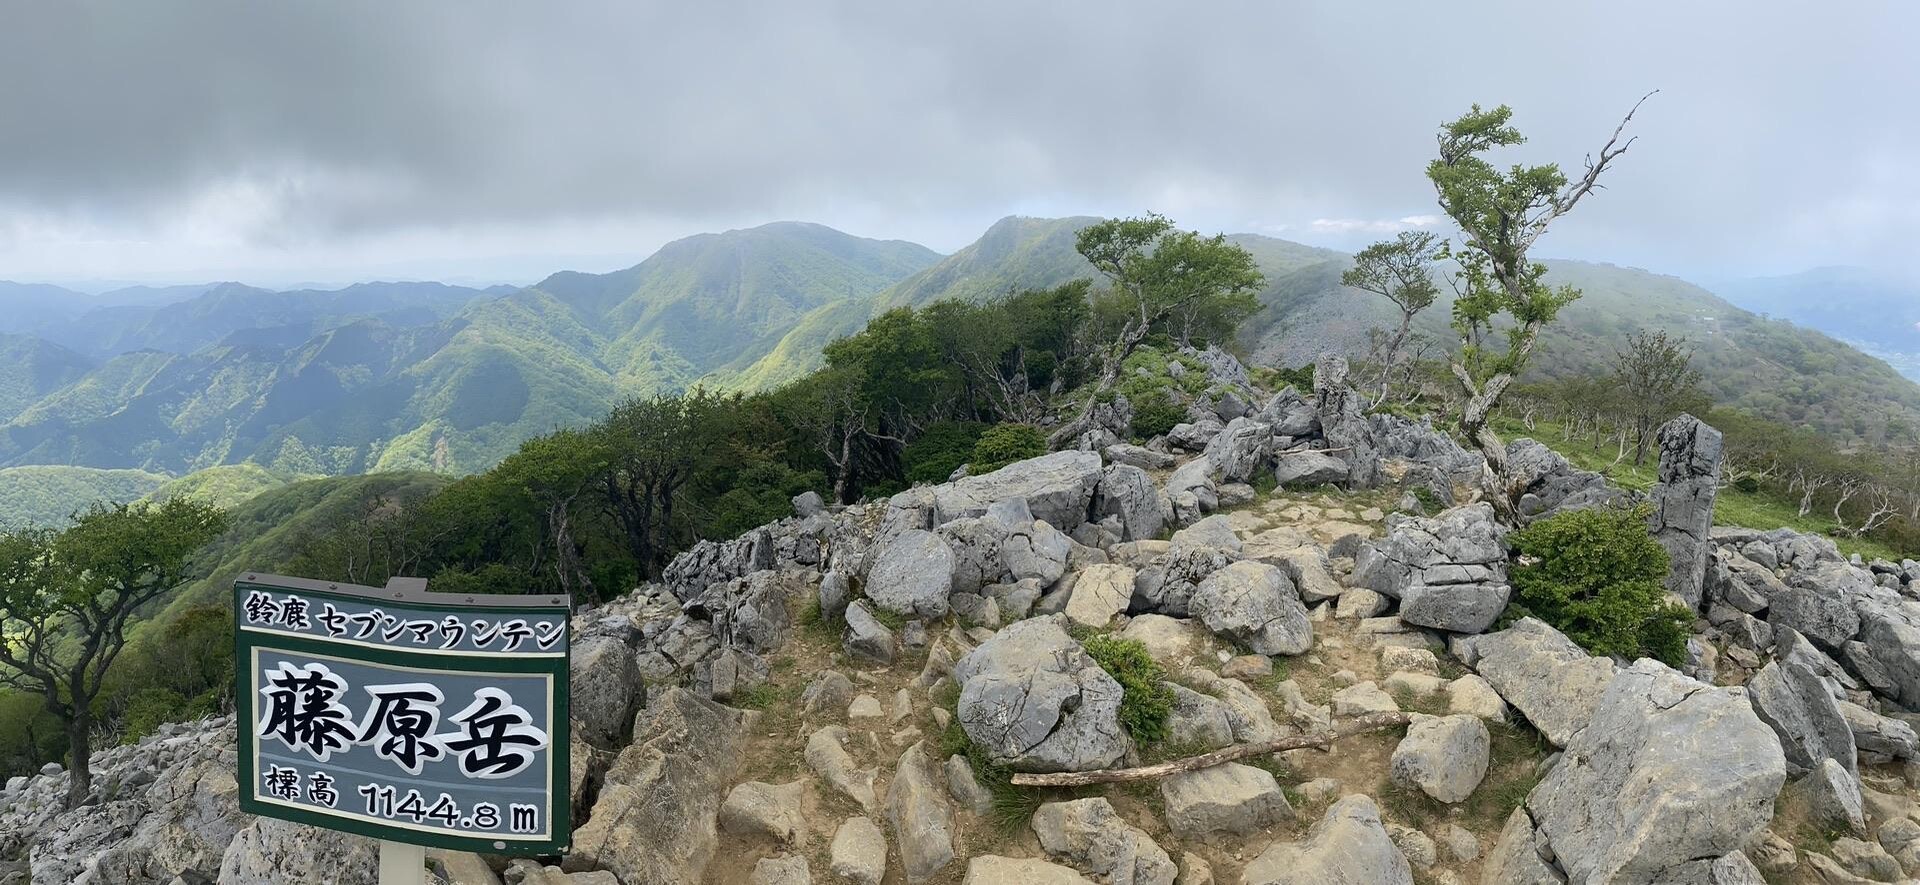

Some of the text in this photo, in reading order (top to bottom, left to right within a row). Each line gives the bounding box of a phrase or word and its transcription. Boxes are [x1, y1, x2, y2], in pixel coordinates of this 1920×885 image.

[246, 592, 565, 650] 鈴鹿 セブンマウンテン
[260, 665, 544, 776] 藤原岳
[265, 766, 537, 832] 標高 1144.8 m
